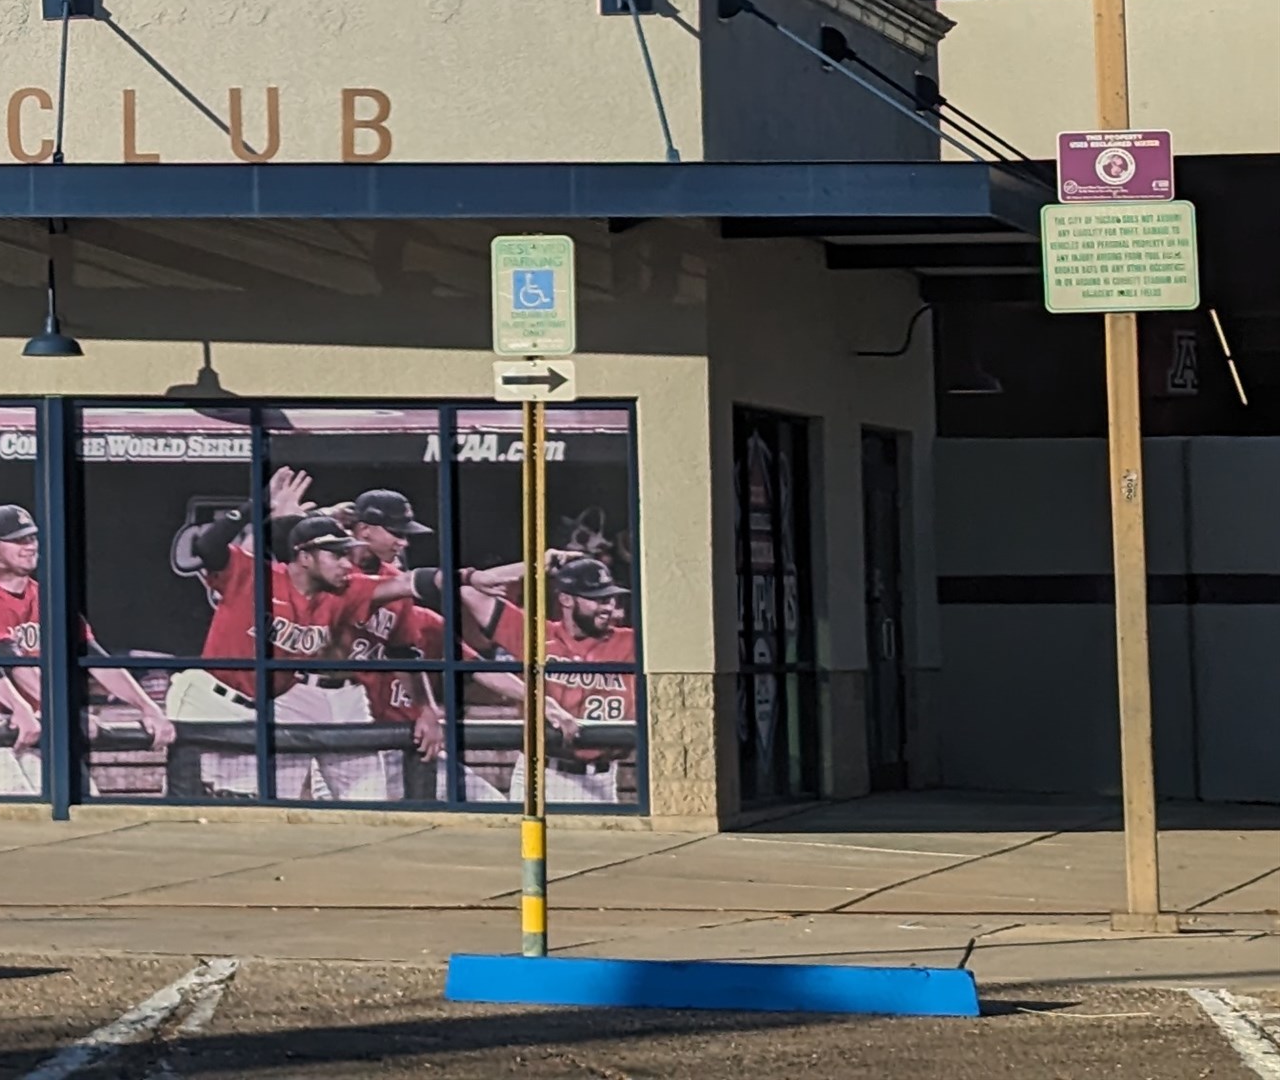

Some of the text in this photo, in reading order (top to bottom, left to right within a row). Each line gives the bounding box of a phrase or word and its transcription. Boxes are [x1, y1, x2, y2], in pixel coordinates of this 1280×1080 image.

[6, 86, 393, 163] CLUB
[108, 435, 253, 461] WORLD SERIE
[584, 694, 625, 722] 28
